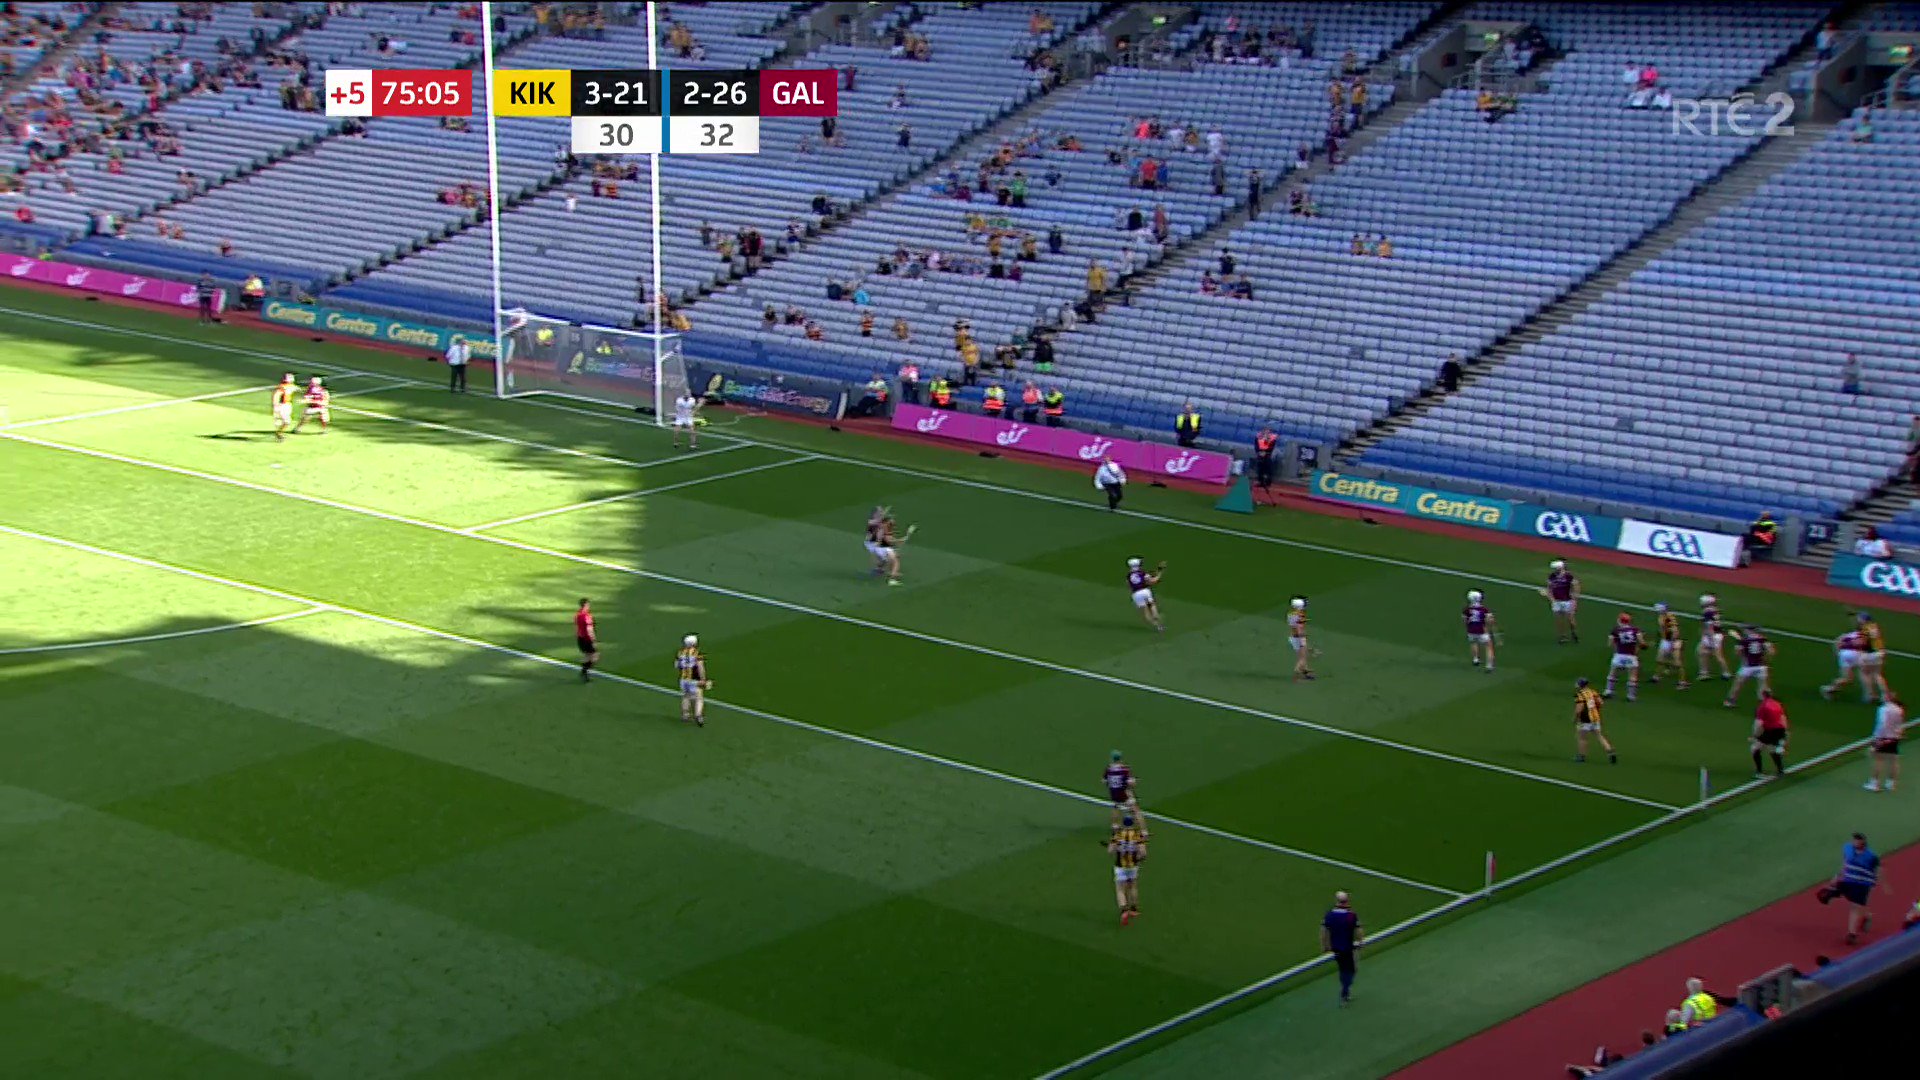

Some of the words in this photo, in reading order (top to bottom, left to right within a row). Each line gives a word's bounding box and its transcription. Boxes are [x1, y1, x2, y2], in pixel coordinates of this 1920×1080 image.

[266, 302, 316, 325] Centra
[326, 312, 377, 336] Centra
[387, 323, 438, 347] Centra
[916, 411, 949, 433] eir
[996, 422, 1030, 446] eir
[1079, 437, 1113, 460] eir
[1165, 450, 1202, 474] eir
[1319, 472, 1400, 504] Centra
[1416, 493, 1500, 525] Centra
